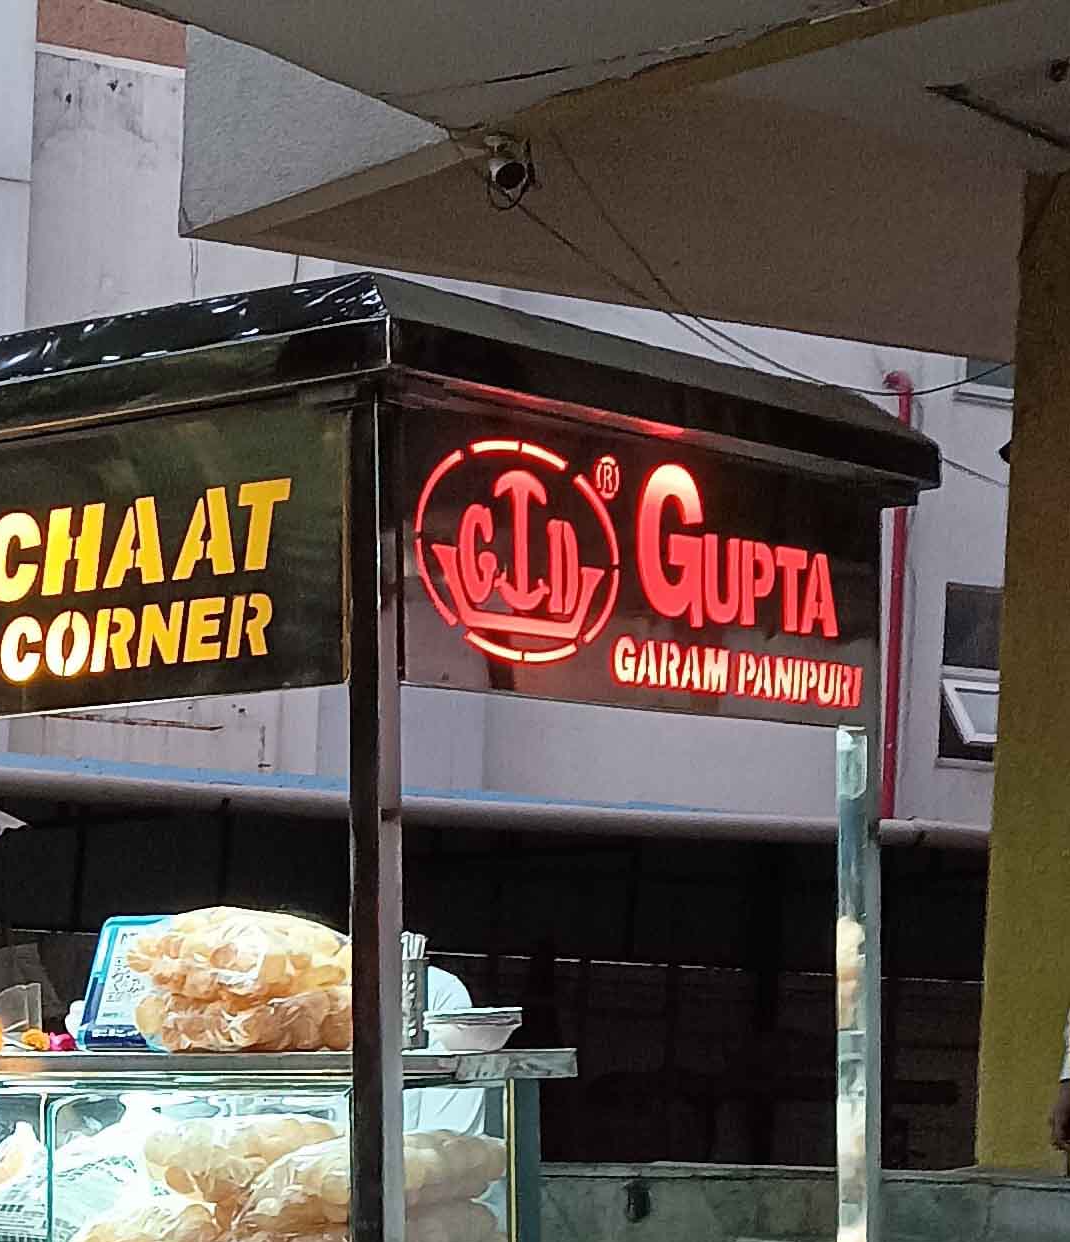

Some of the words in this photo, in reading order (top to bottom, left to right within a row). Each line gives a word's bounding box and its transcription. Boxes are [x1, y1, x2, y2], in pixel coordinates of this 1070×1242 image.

[636, 464, 840, 638] GUPTA
[0, 593, 273, 682] CORNER
[614, 636, 730, 694] GARAM
[736, 651, 863, 708] PANIPURI
